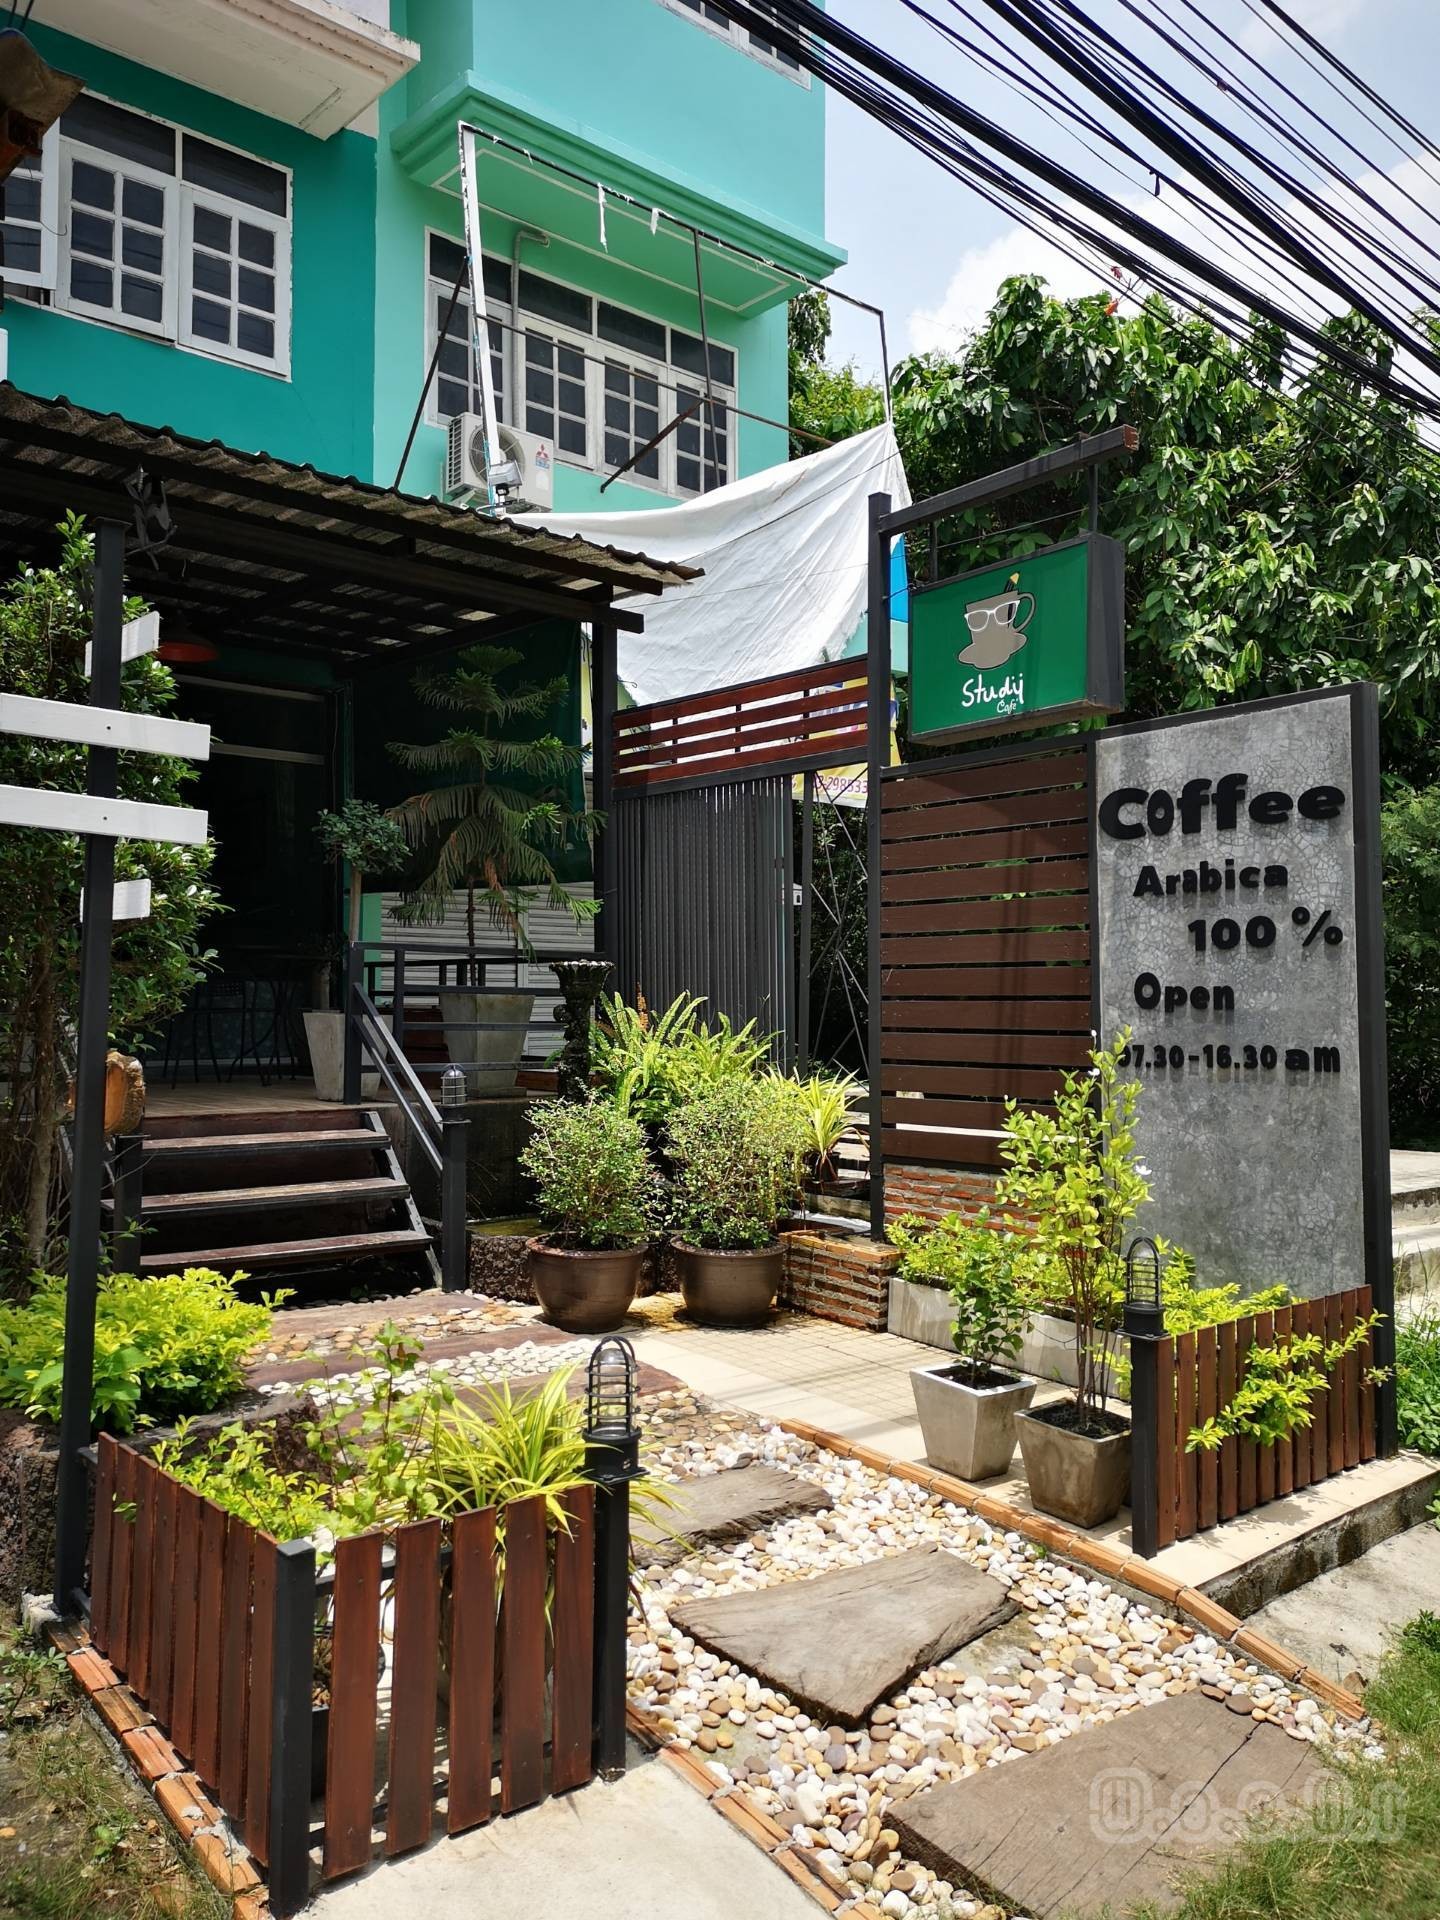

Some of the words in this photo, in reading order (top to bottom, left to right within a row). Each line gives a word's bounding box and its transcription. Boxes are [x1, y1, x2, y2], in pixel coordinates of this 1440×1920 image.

[961, 673, 1024, 707] Study
[1099, 773, 1346, 840] Coffee
[1132, 858, 1289, 896] Arabica
[1134, 972, 1235, 1013] Open
